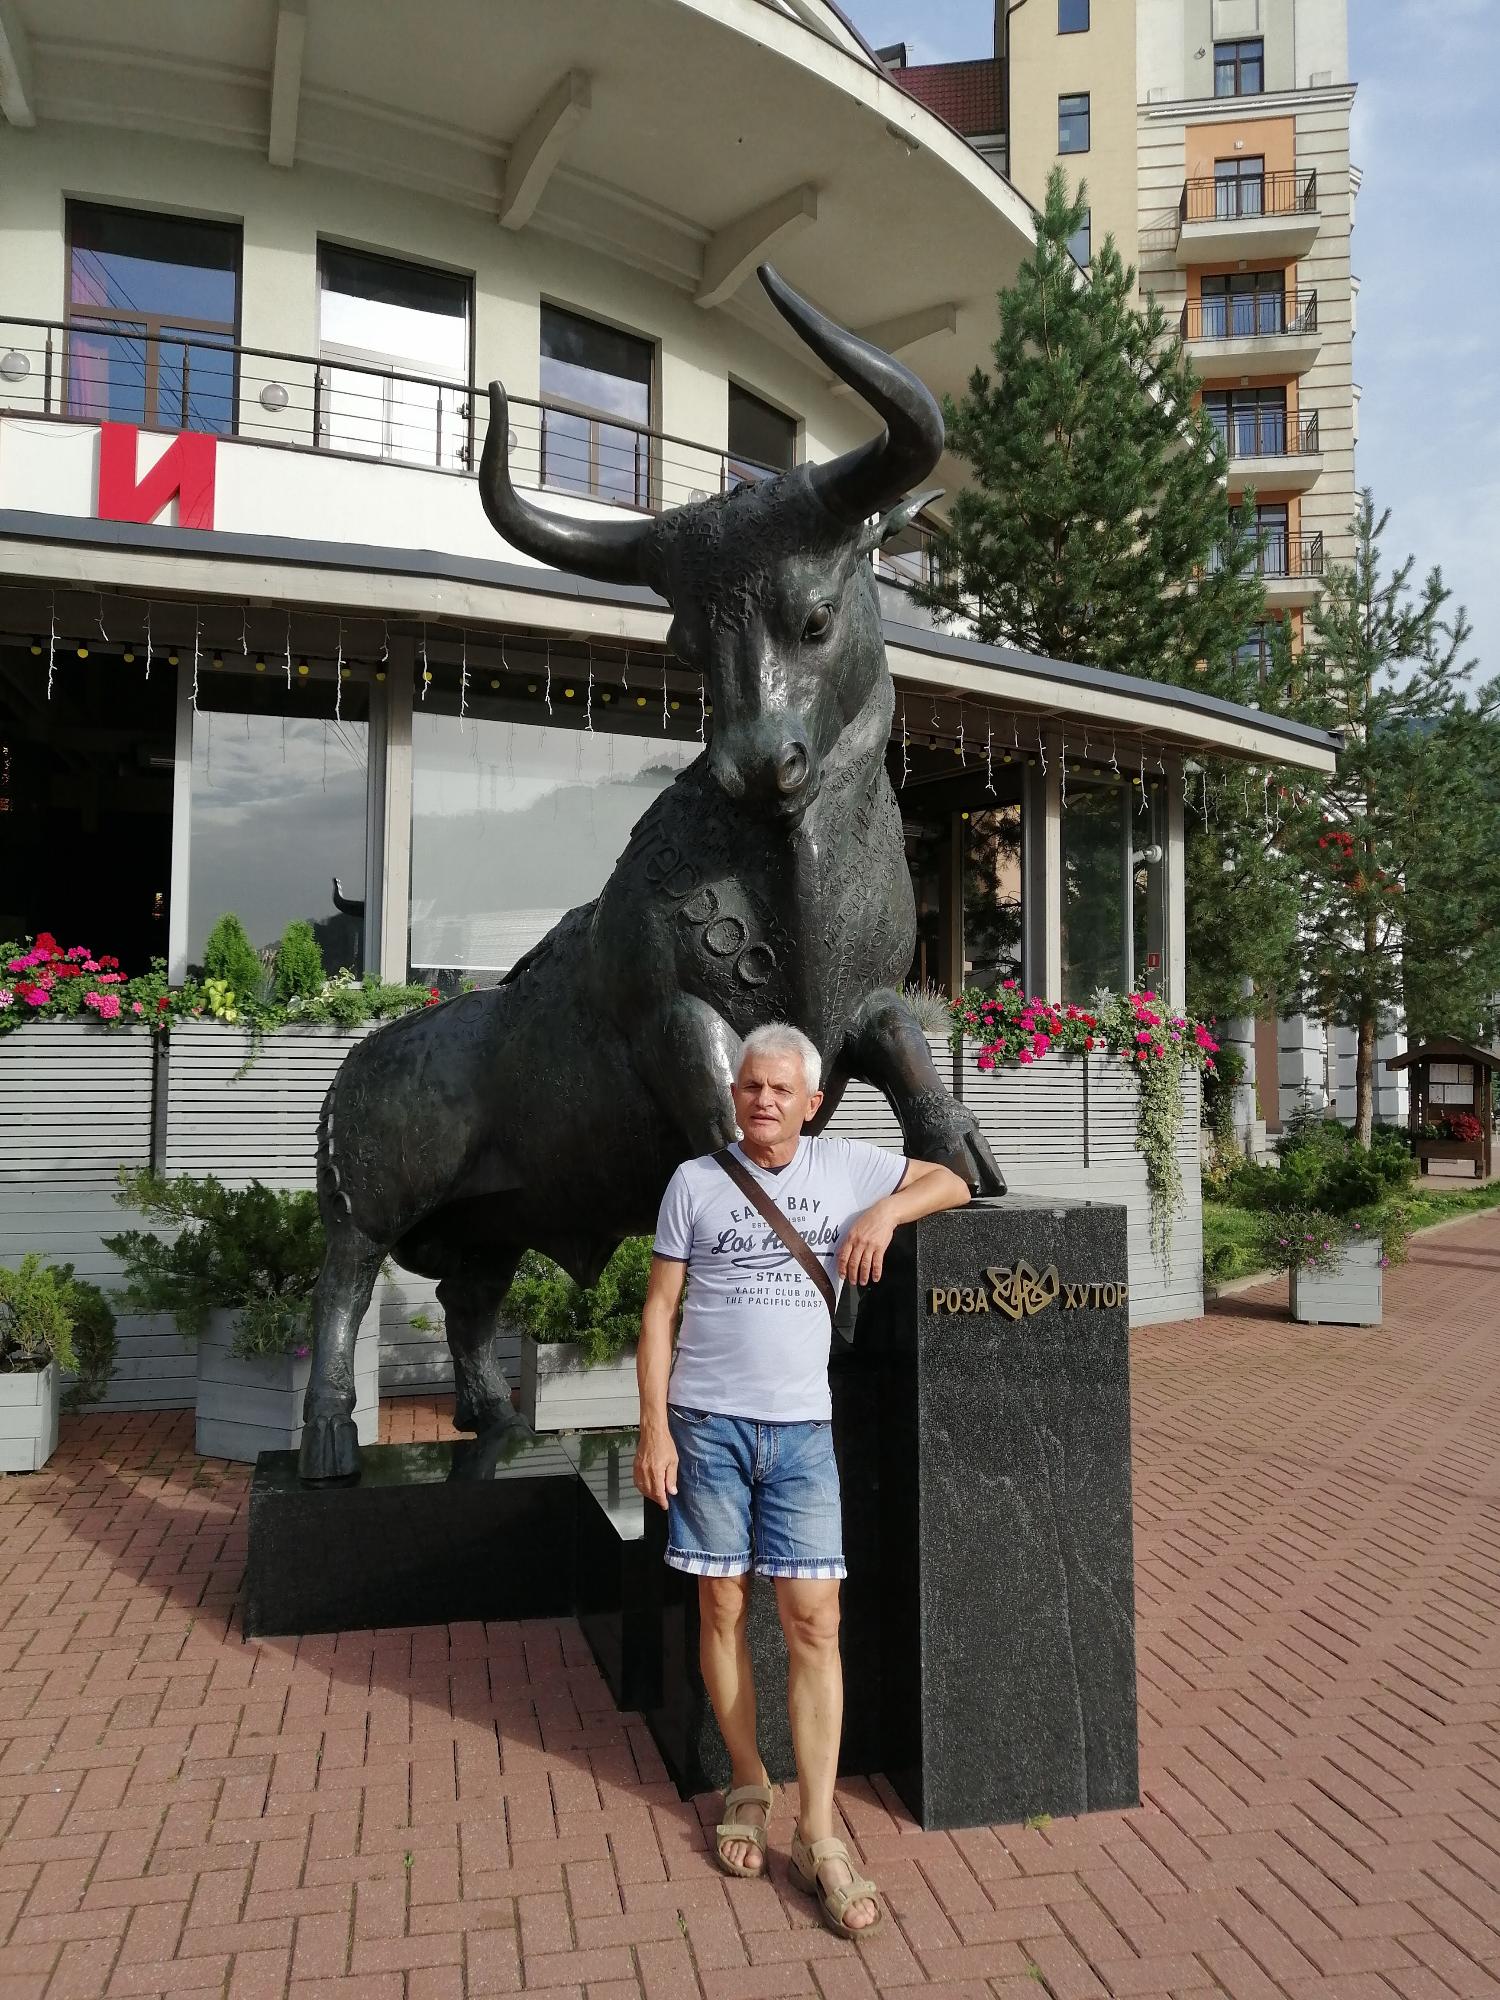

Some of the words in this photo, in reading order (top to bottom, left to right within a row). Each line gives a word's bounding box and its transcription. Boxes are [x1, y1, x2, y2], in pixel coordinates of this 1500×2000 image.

[98, 422, 217, 531] И
[730, 1198, 778, 1223] EA
[787, 1196, 821, 1213] BAY
[711, 1228, 756, 1255] Los
[756, 1272, 802, 1283] STATE
[725, 1296, 743, 1305] THE
[748, 1297, 791, 1307] PACIFIC
[794, 1300, 823, 1308] COAST
[735, 1287, 770, 1295] YACHT
[775, 1288, 801, 1297] CLUB
[804, 1289, 816, 1299] ON
[932, 1288, 990, 1313] РОЗА
[1062, 1283, 1129, 1308] ХУТОР
